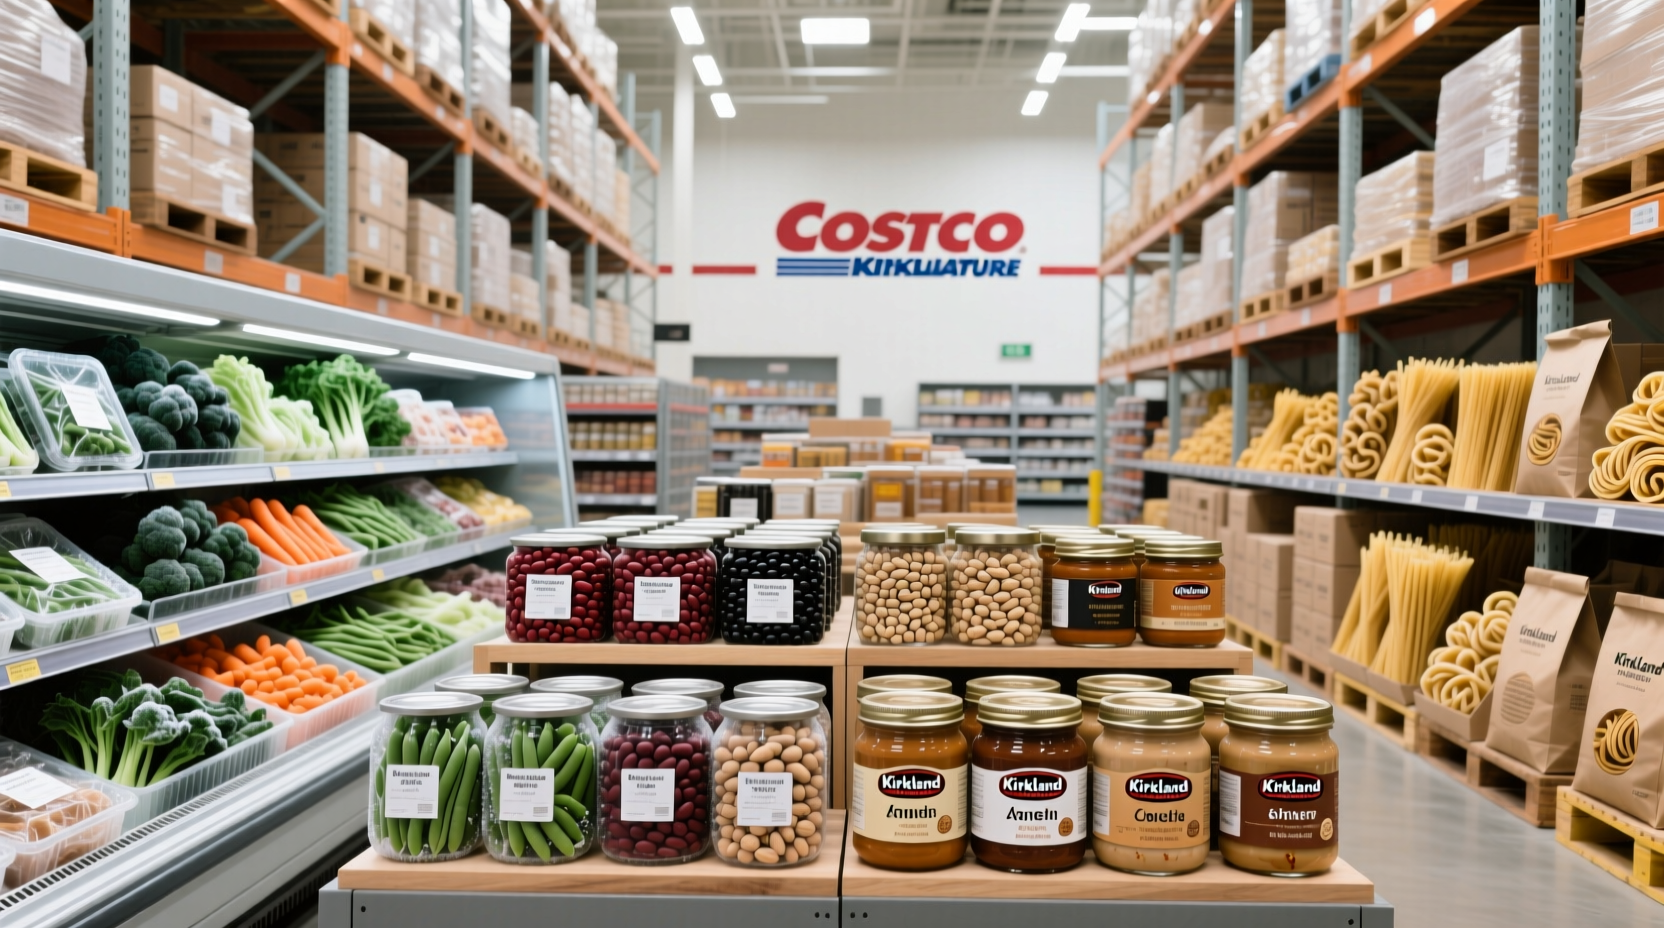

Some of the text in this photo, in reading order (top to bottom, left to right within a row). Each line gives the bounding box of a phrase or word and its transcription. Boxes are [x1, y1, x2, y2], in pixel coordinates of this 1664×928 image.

[776, 200, 1025, 253] COSTCO
[882, 774, 941, 790] Kirkland
[1003, 777, 1063, 792] Kirkland
[1129, 778, 1188, 793] Kirkland
